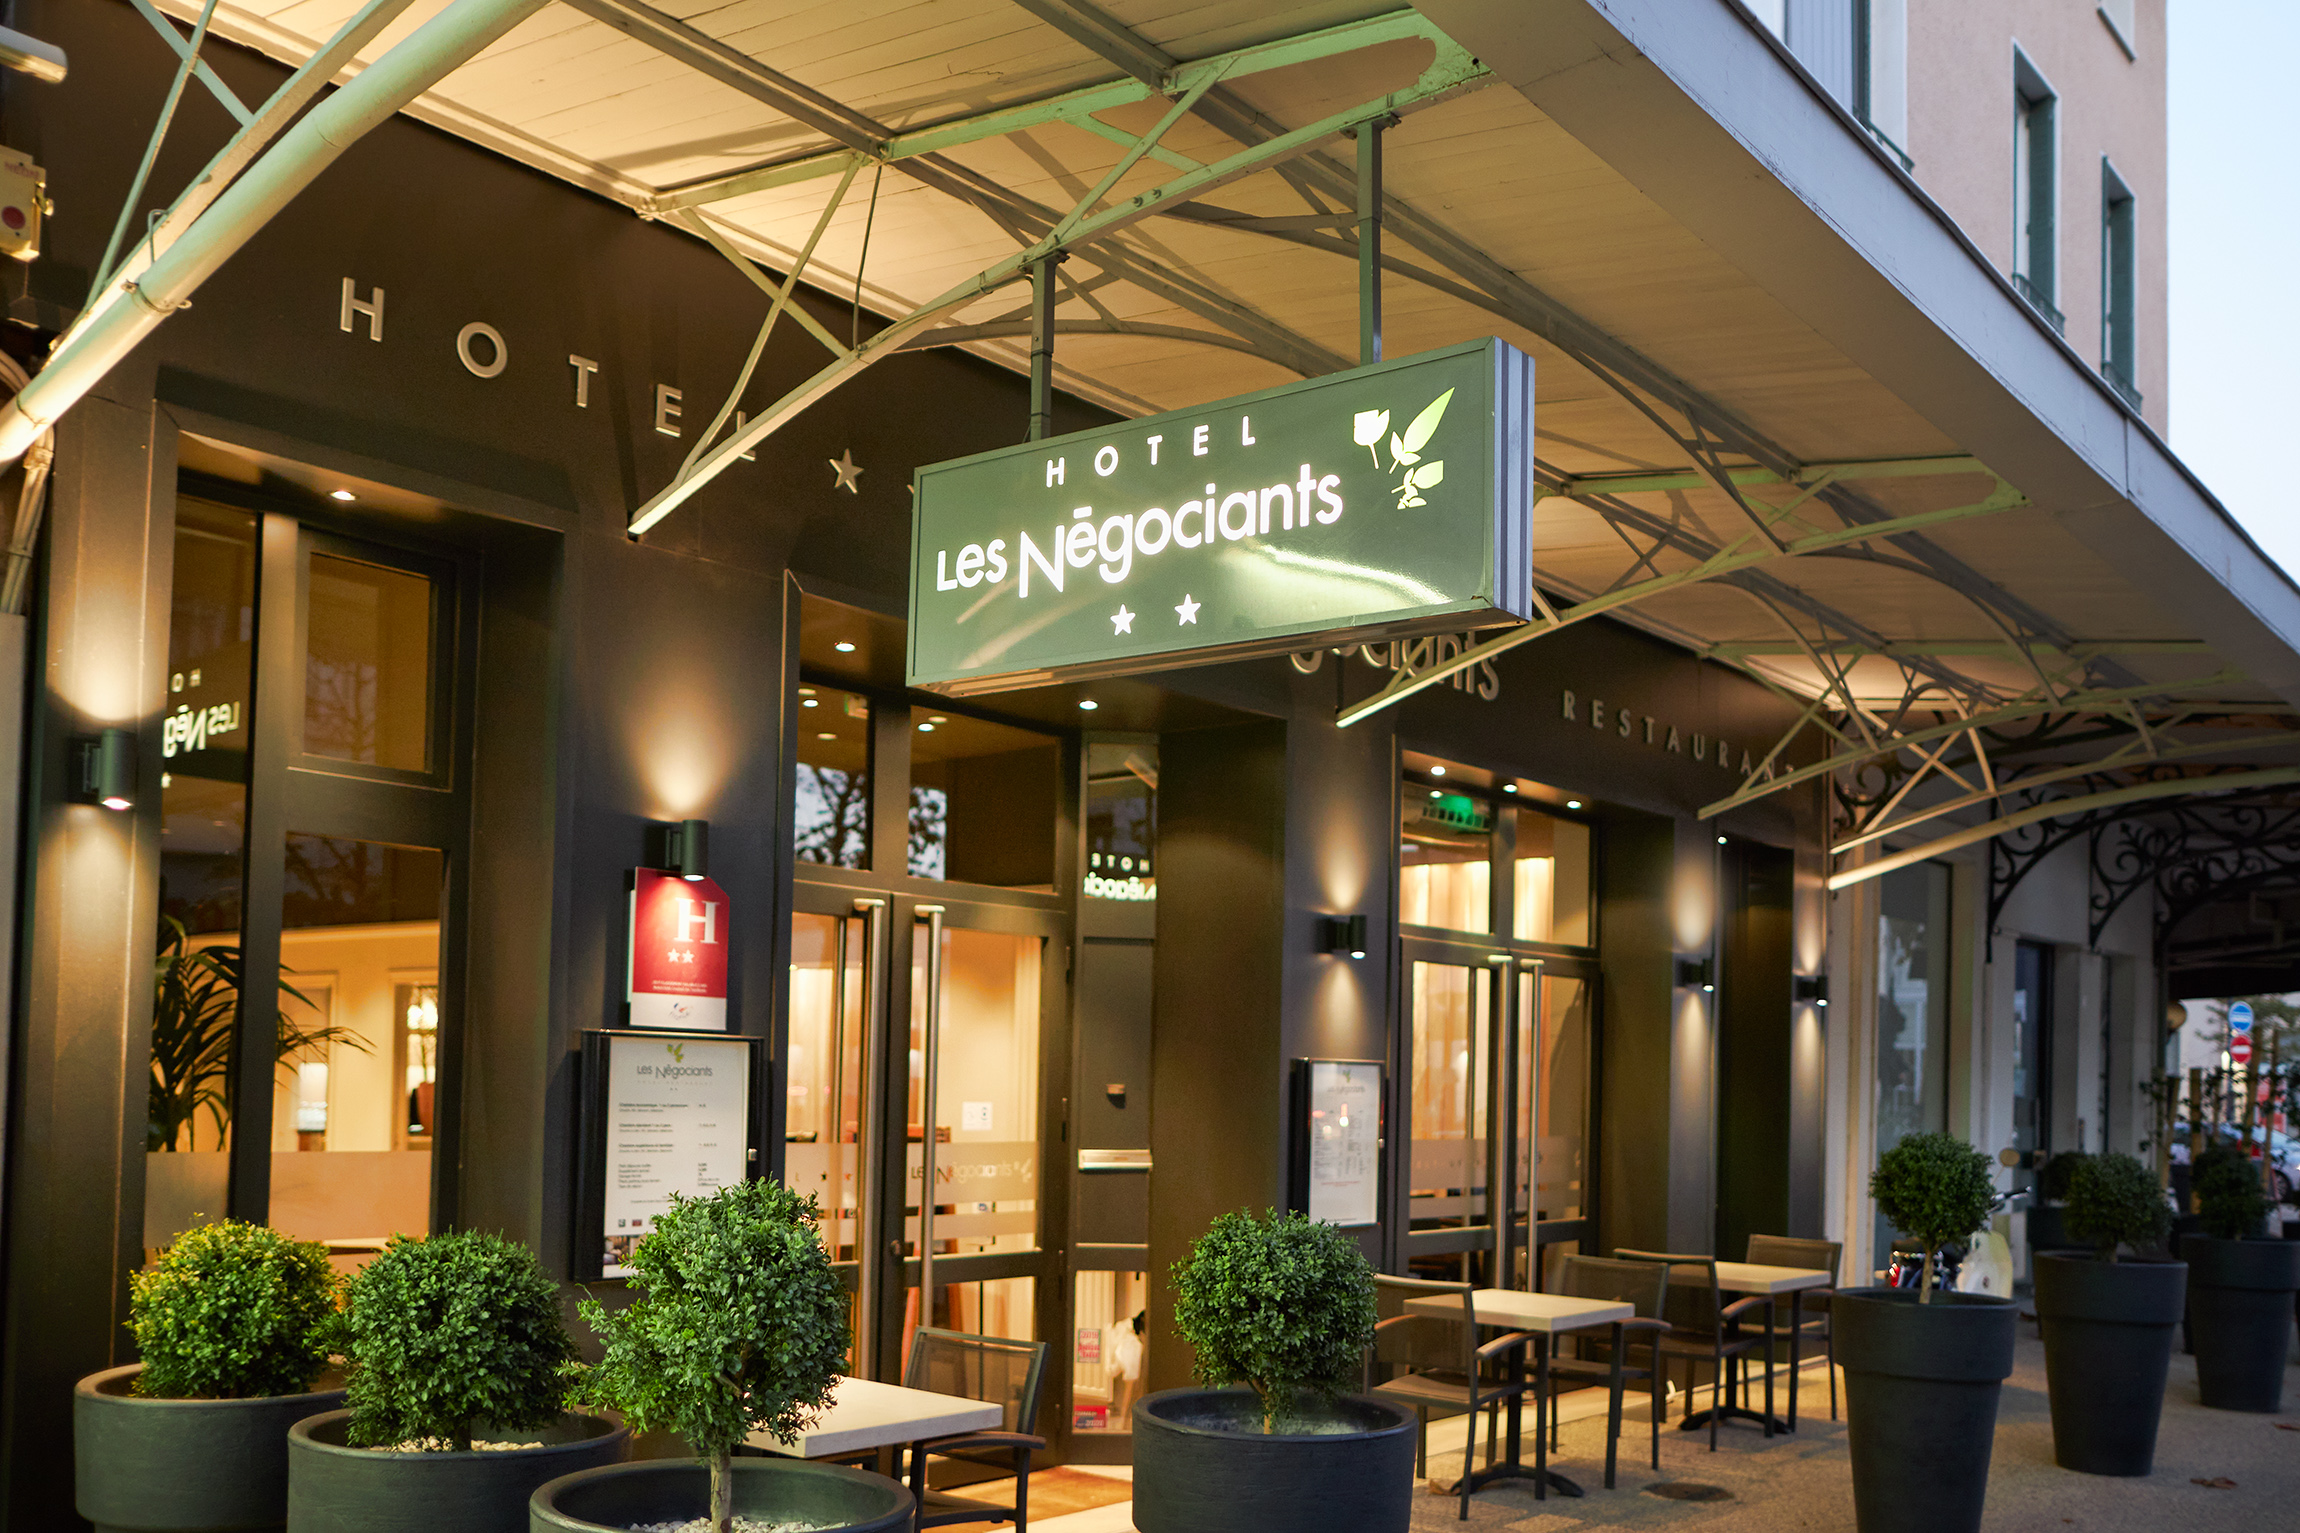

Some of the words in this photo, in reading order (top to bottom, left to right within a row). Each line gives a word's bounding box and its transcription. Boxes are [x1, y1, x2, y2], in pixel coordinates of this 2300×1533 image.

[1046, 415, 1256, 488] HOTEL
[936, 538, 1008, 592] Les
[673, 897, 721, 945] H
